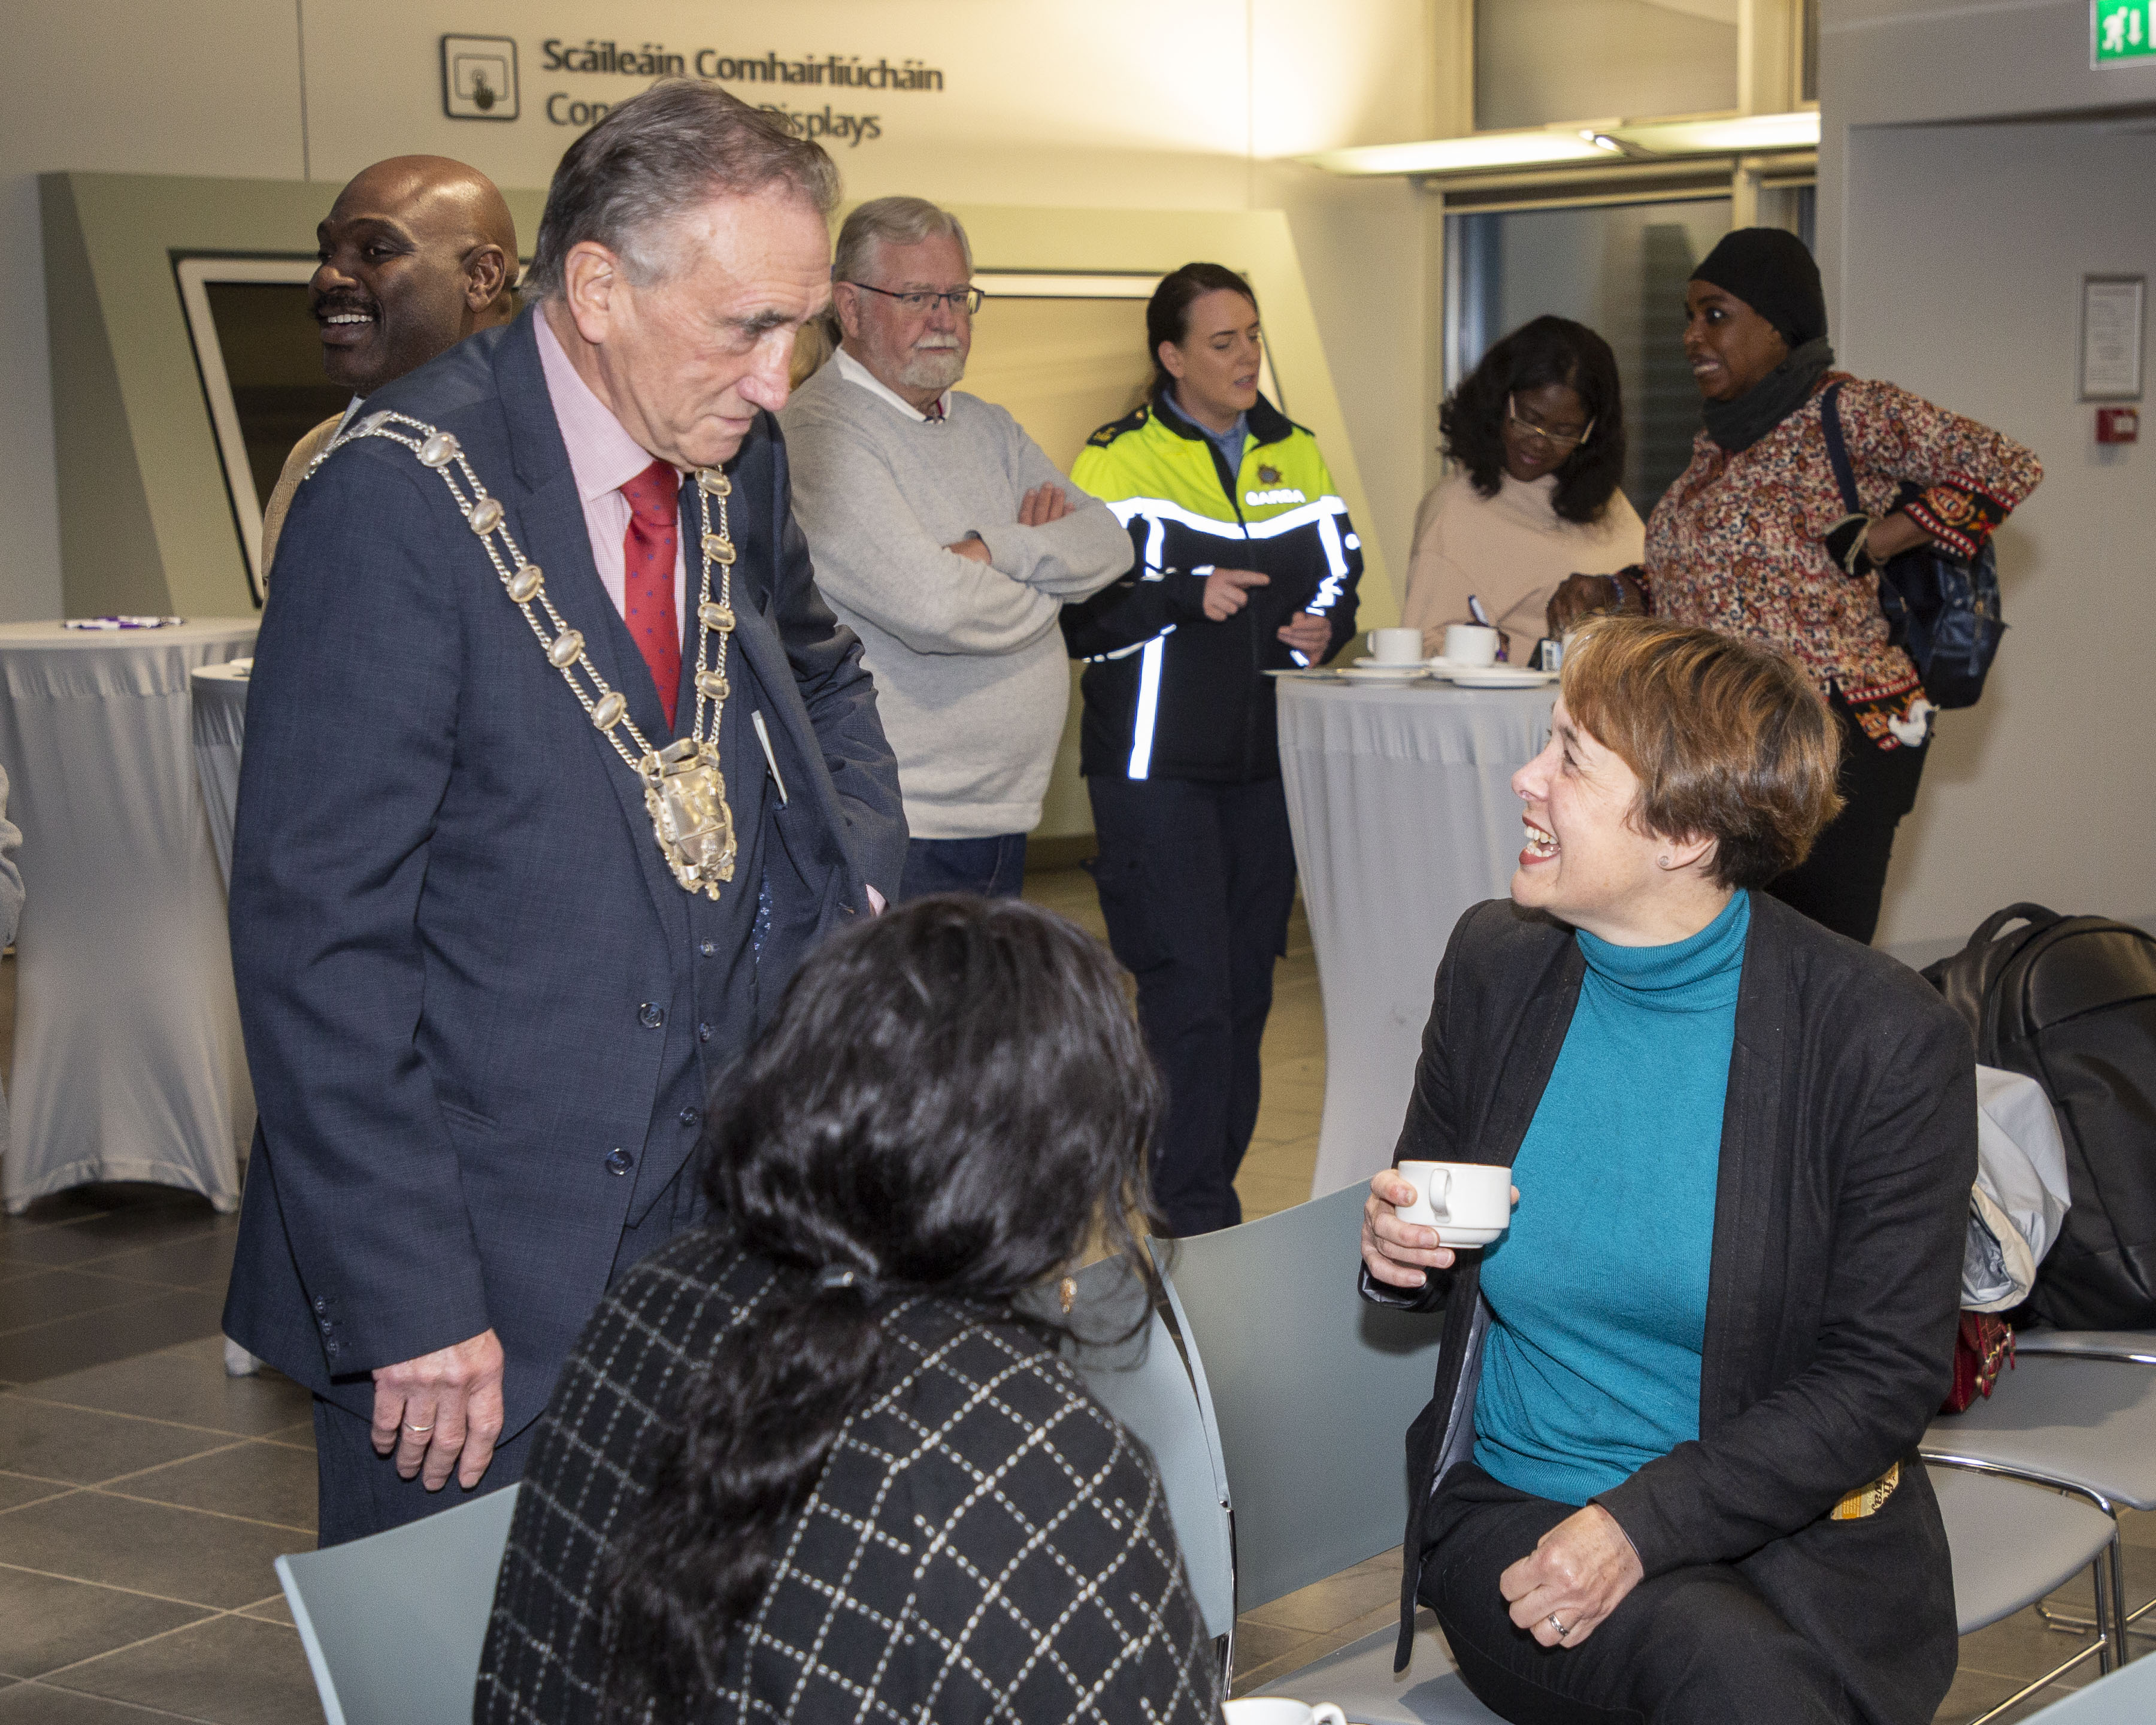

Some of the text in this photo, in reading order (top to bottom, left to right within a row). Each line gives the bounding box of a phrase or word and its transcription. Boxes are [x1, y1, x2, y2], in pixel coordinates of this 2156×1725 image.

[543, 38, 945, 92] Scáileáin Comhairliúcháin
[758, 103, 882, 147] splays
